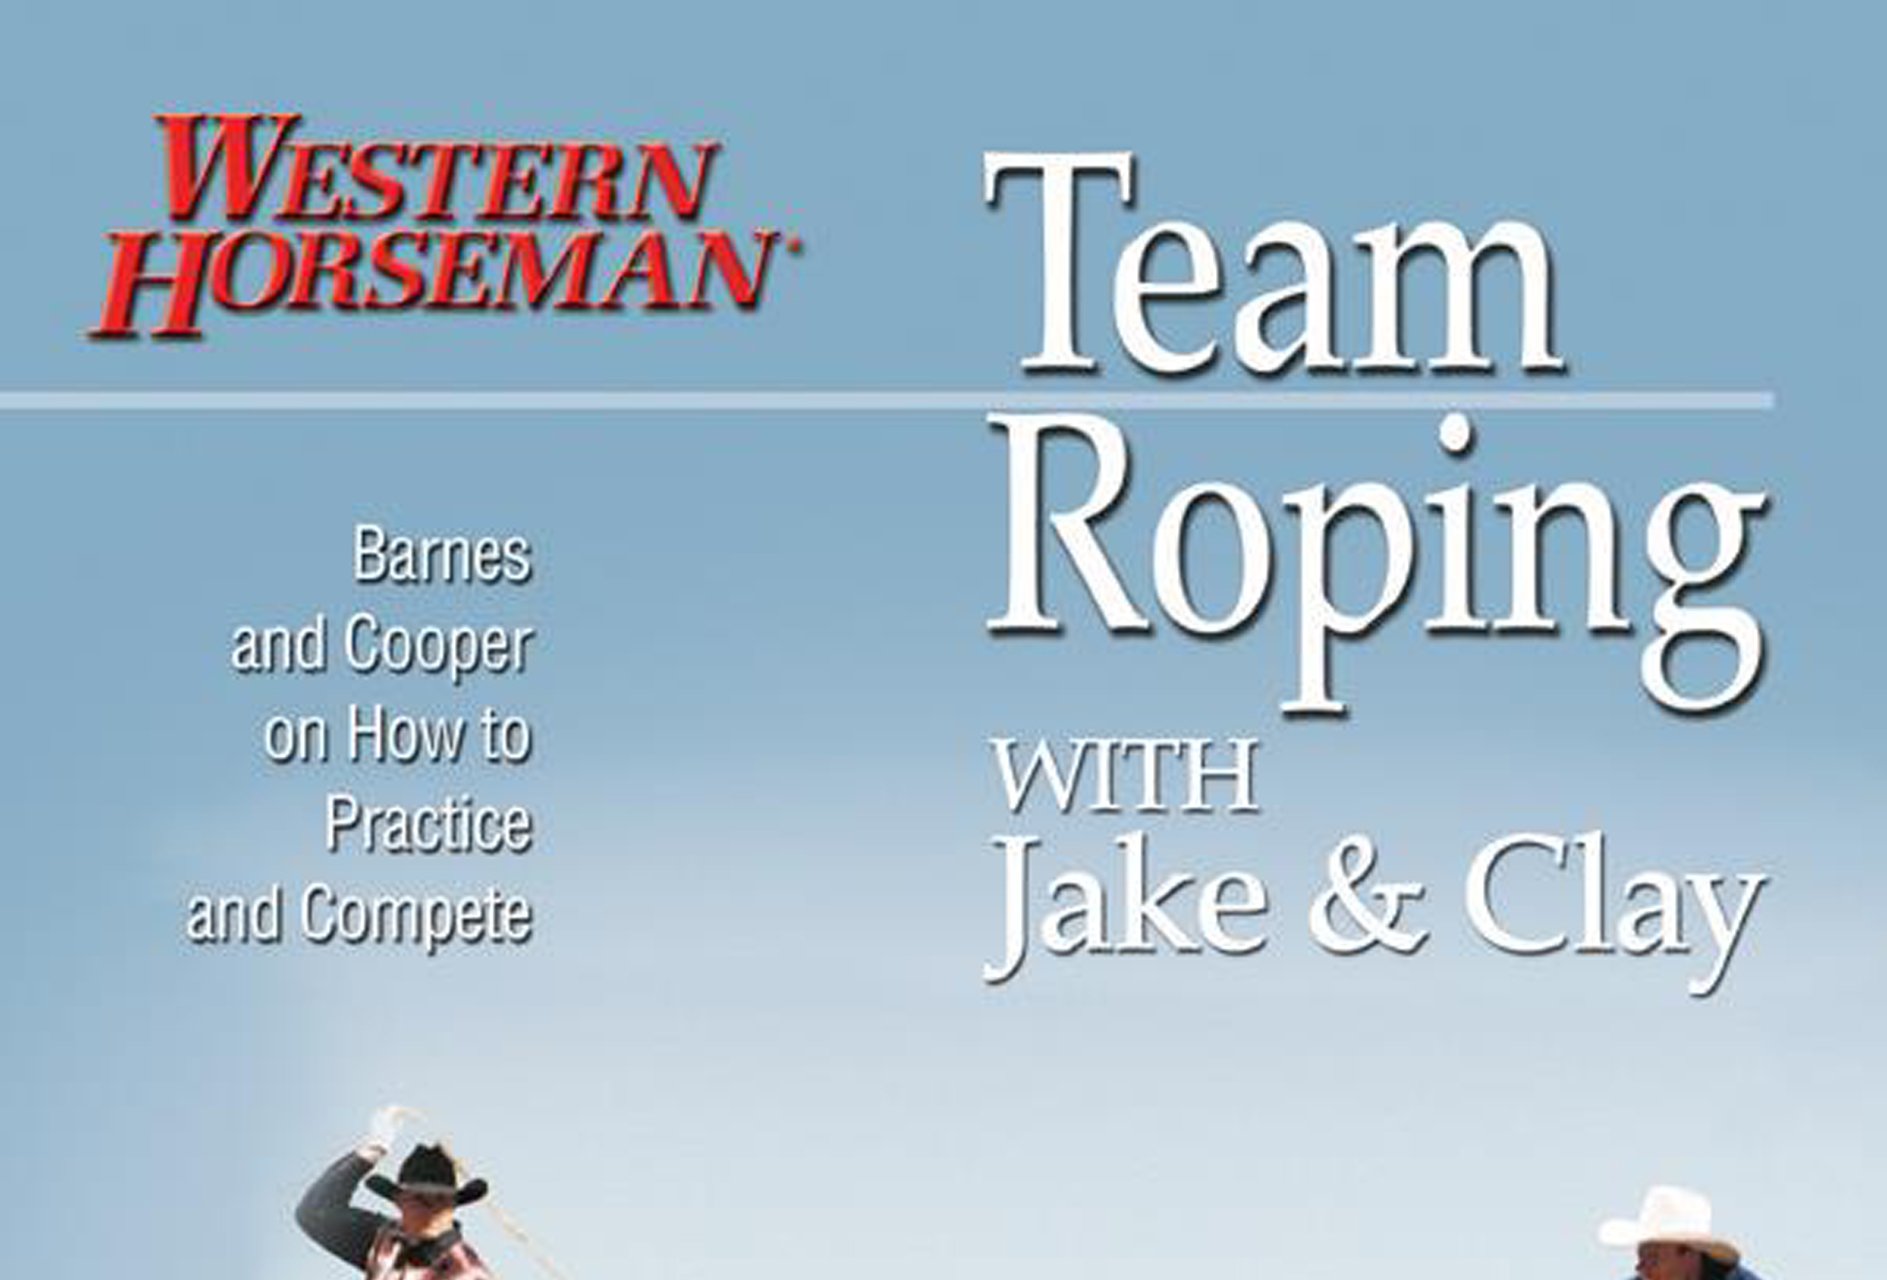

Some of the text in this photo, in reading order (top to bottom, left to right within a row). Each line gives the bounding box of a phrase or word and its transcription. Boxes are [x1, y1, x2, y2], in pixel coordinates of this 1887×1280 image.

[152, 112, 720, 222] WESTERN
[983, 151, 1565, 375] Team
[353, 523, 534, 584] Barnes
[985, 411, 1768, 717] Roping
[230, 611, 536, 685] and Cooper
[263, 703, 534, 763] on How to
[990, 736, 1260, 813] WITH
[325, 793, 535, 855] Practice
[186, 882, 534, 956] and Compete
[983, 829, 1769, 996] Jake & Clay
